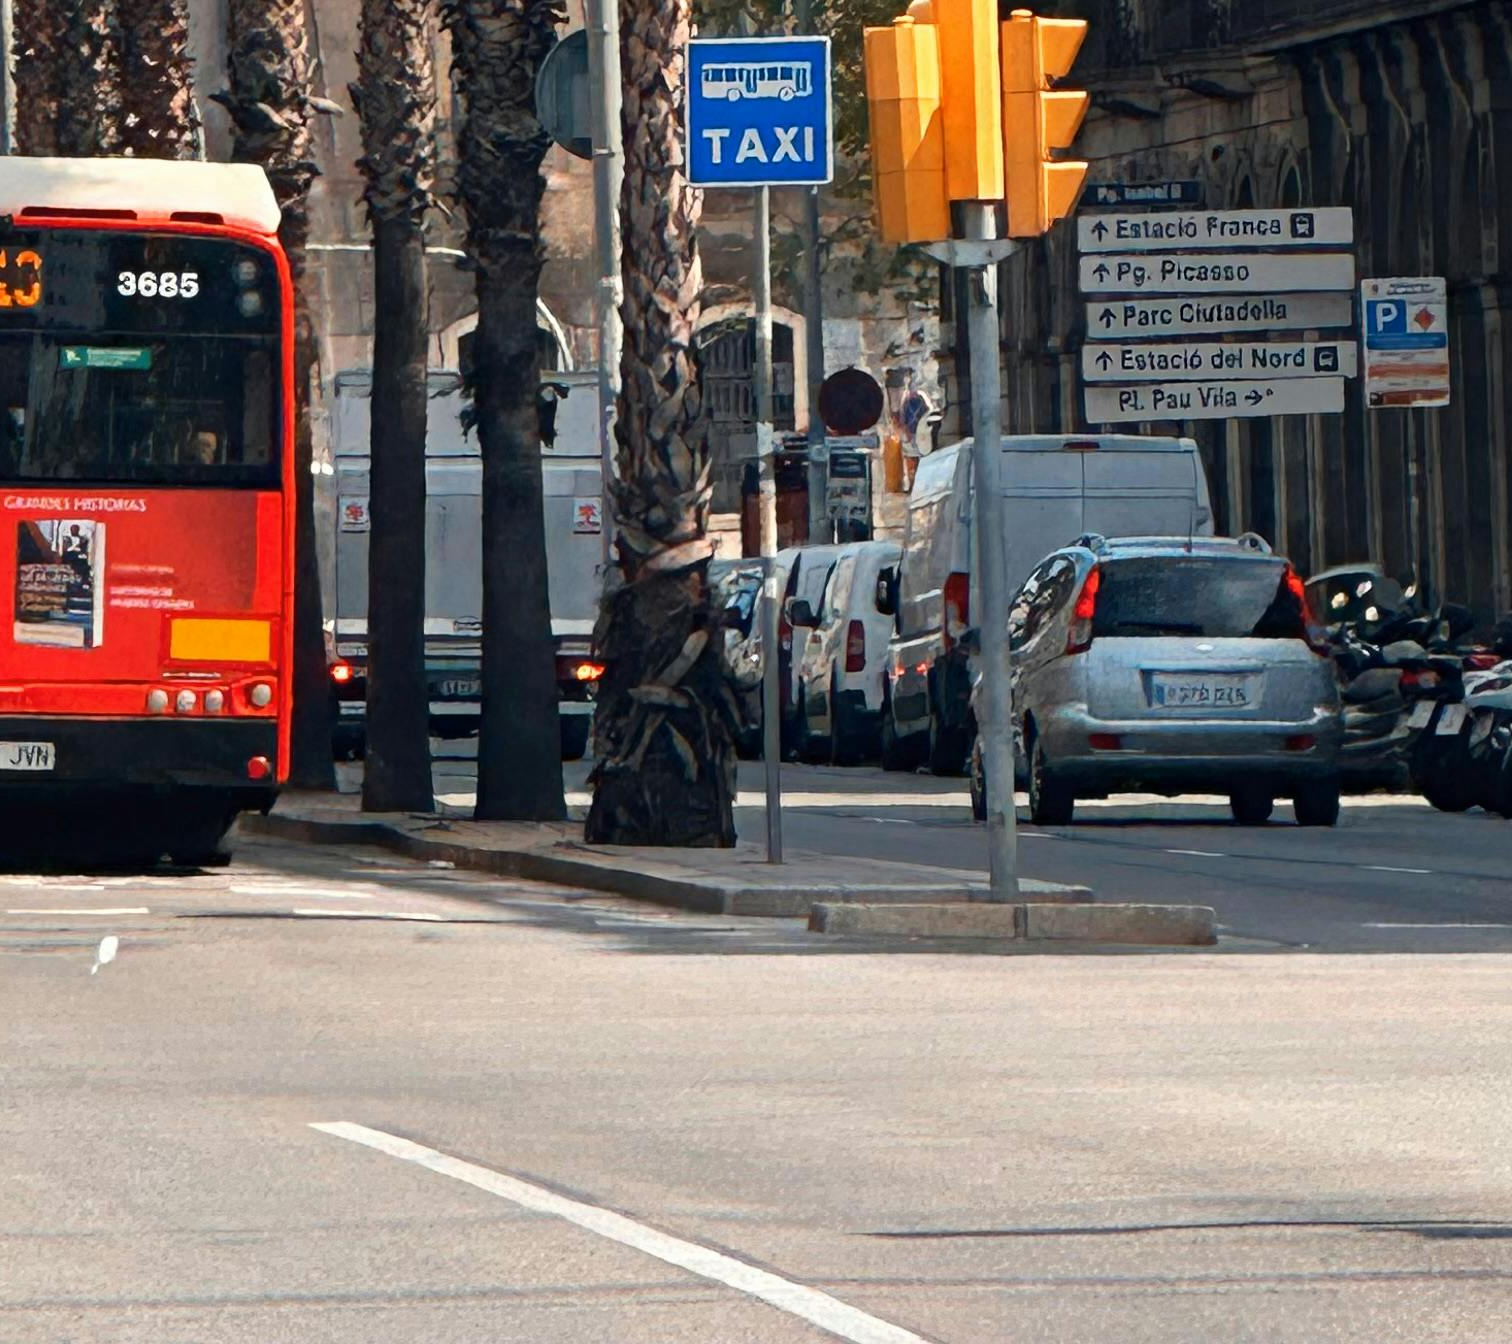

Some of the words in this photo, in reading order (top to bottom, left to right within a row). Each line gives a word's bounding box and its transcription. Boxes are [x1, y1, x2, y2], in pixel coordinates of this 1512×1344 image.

[701, 126, 815, 164] TAXI
[1116, 216, 1198, 239] Estació
[117, 271, 199, 298] 3685
[1116, 262, 1151, 286] Pg.
[1161, 260, 1250, 282] Picasso
[1123, 304, 1173, 328] Parc
[1179, 299, 1288, 324] Ciutadella
[1375, 302, 1398, 332] P
[1120, 348, 1203, 371] Estació
[1210, 348, 1243, 370] del
[1251, 347, 1306, 369] Nord
[1152, 388, 1191, 411] Pau
[1197, 386, 1238, 409] Vila
[10, 744, 49, 767] JVN
